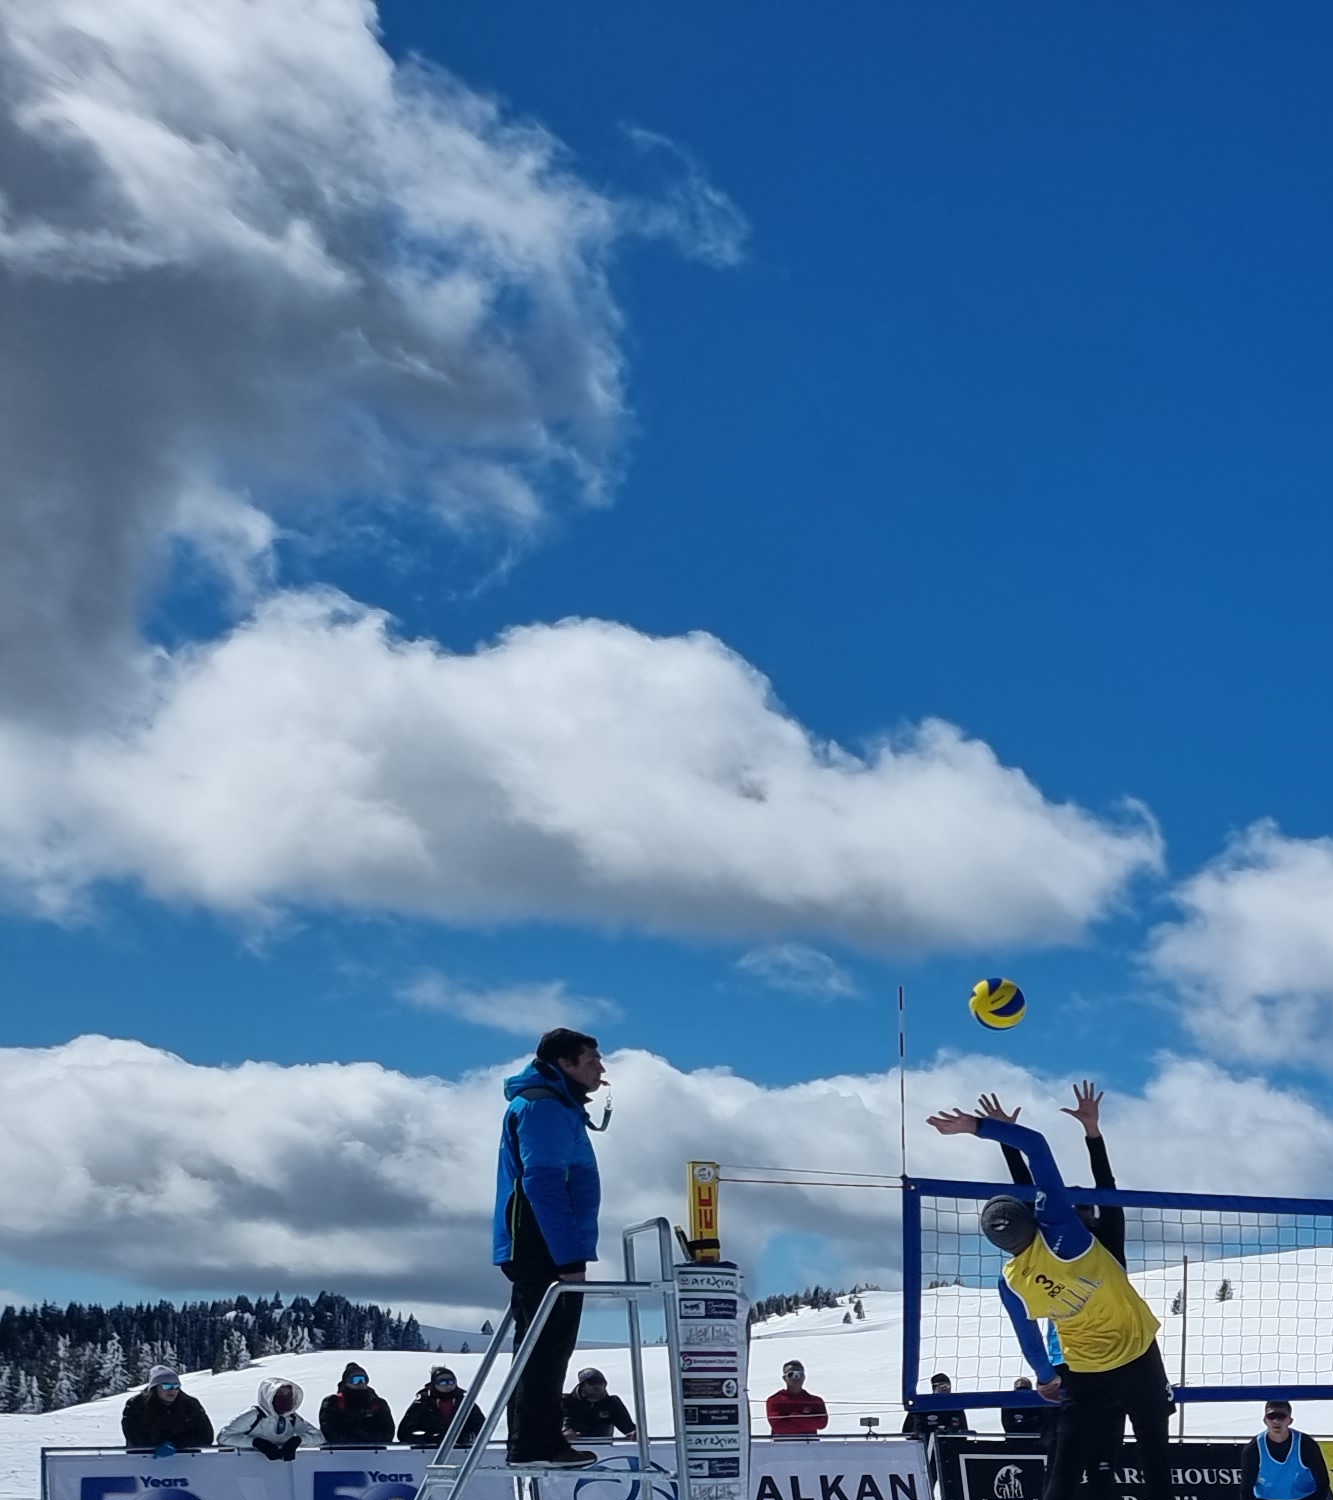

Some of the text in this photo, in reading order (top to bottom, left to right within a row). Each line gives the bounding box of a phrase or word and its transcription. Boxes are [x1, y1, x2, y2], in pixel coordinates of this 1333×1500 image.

[1035, 1274, 1054, 1290] 3
[139, 1476, 189, 1488] Years
[368, 1471, 414, 1483] Years
[1170, 1468, 1242, 1485] HOUSE
